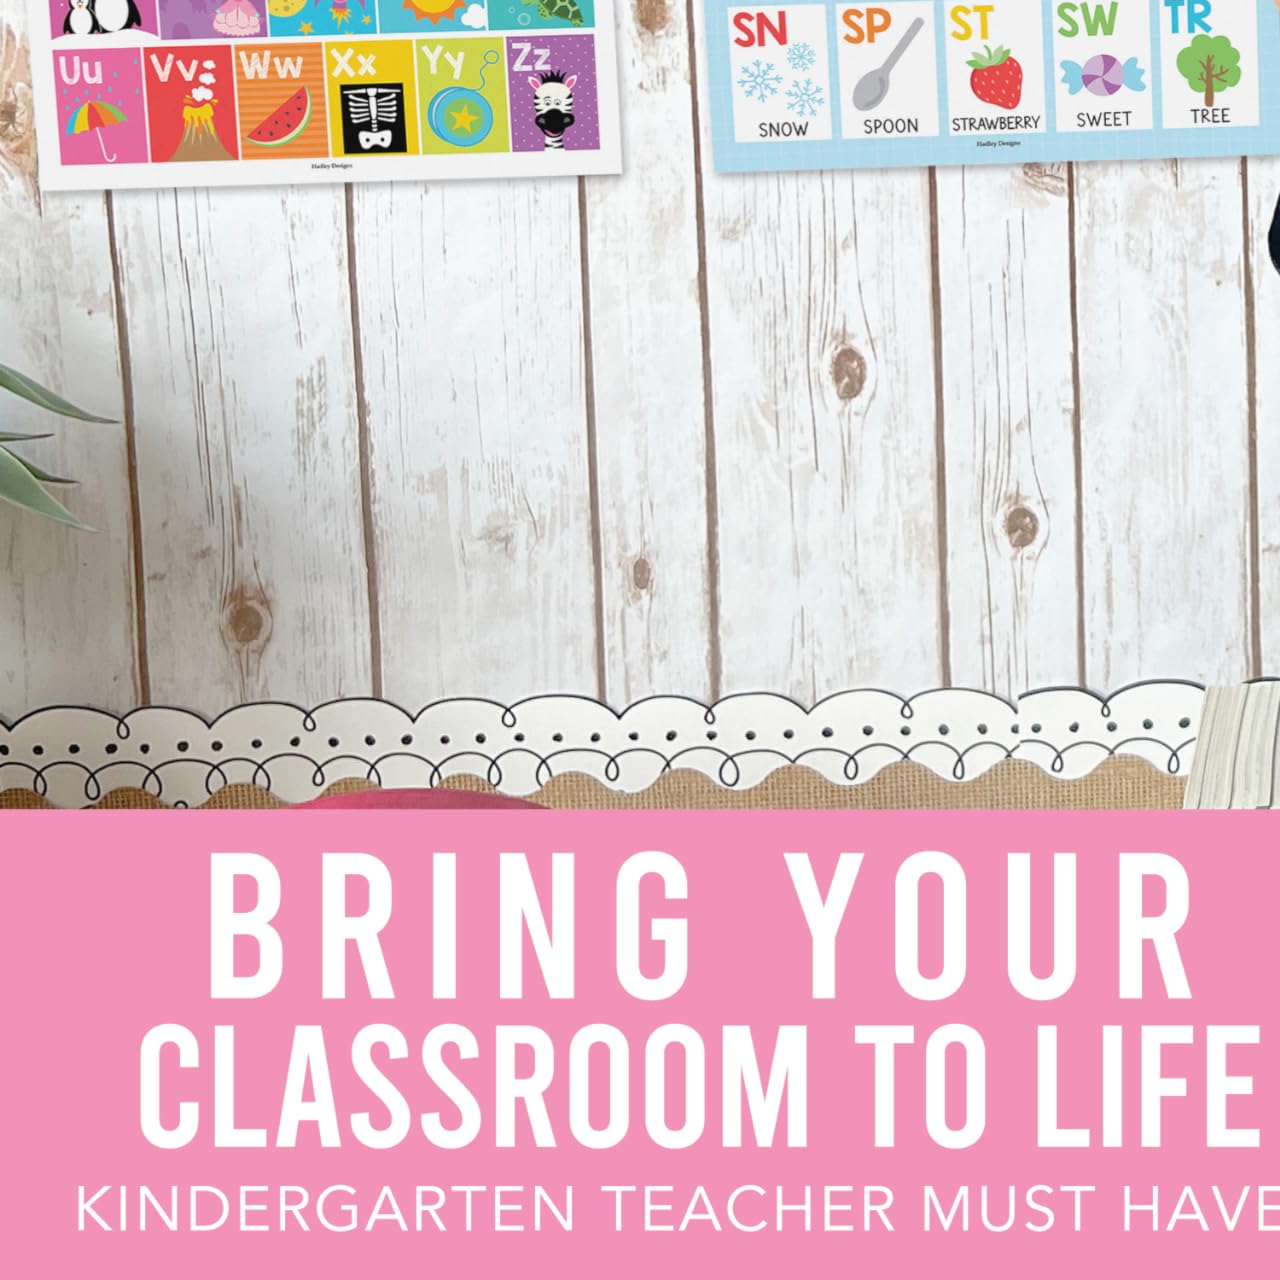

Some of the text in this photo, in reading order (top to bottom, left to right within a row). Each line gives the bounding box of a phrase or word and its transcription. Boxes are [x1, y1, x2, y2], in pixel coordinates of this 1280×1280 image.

[1057, 1, 1118, 38] SW
[511, 43, 555, 76] Zz
[1077, 111, 1132, 127] SWEET
[1190, 108, 1230, 123] TREE
[759, 122, 808, 137] SNOW
[952, 116, 1040, 131] STRAWBERRY
